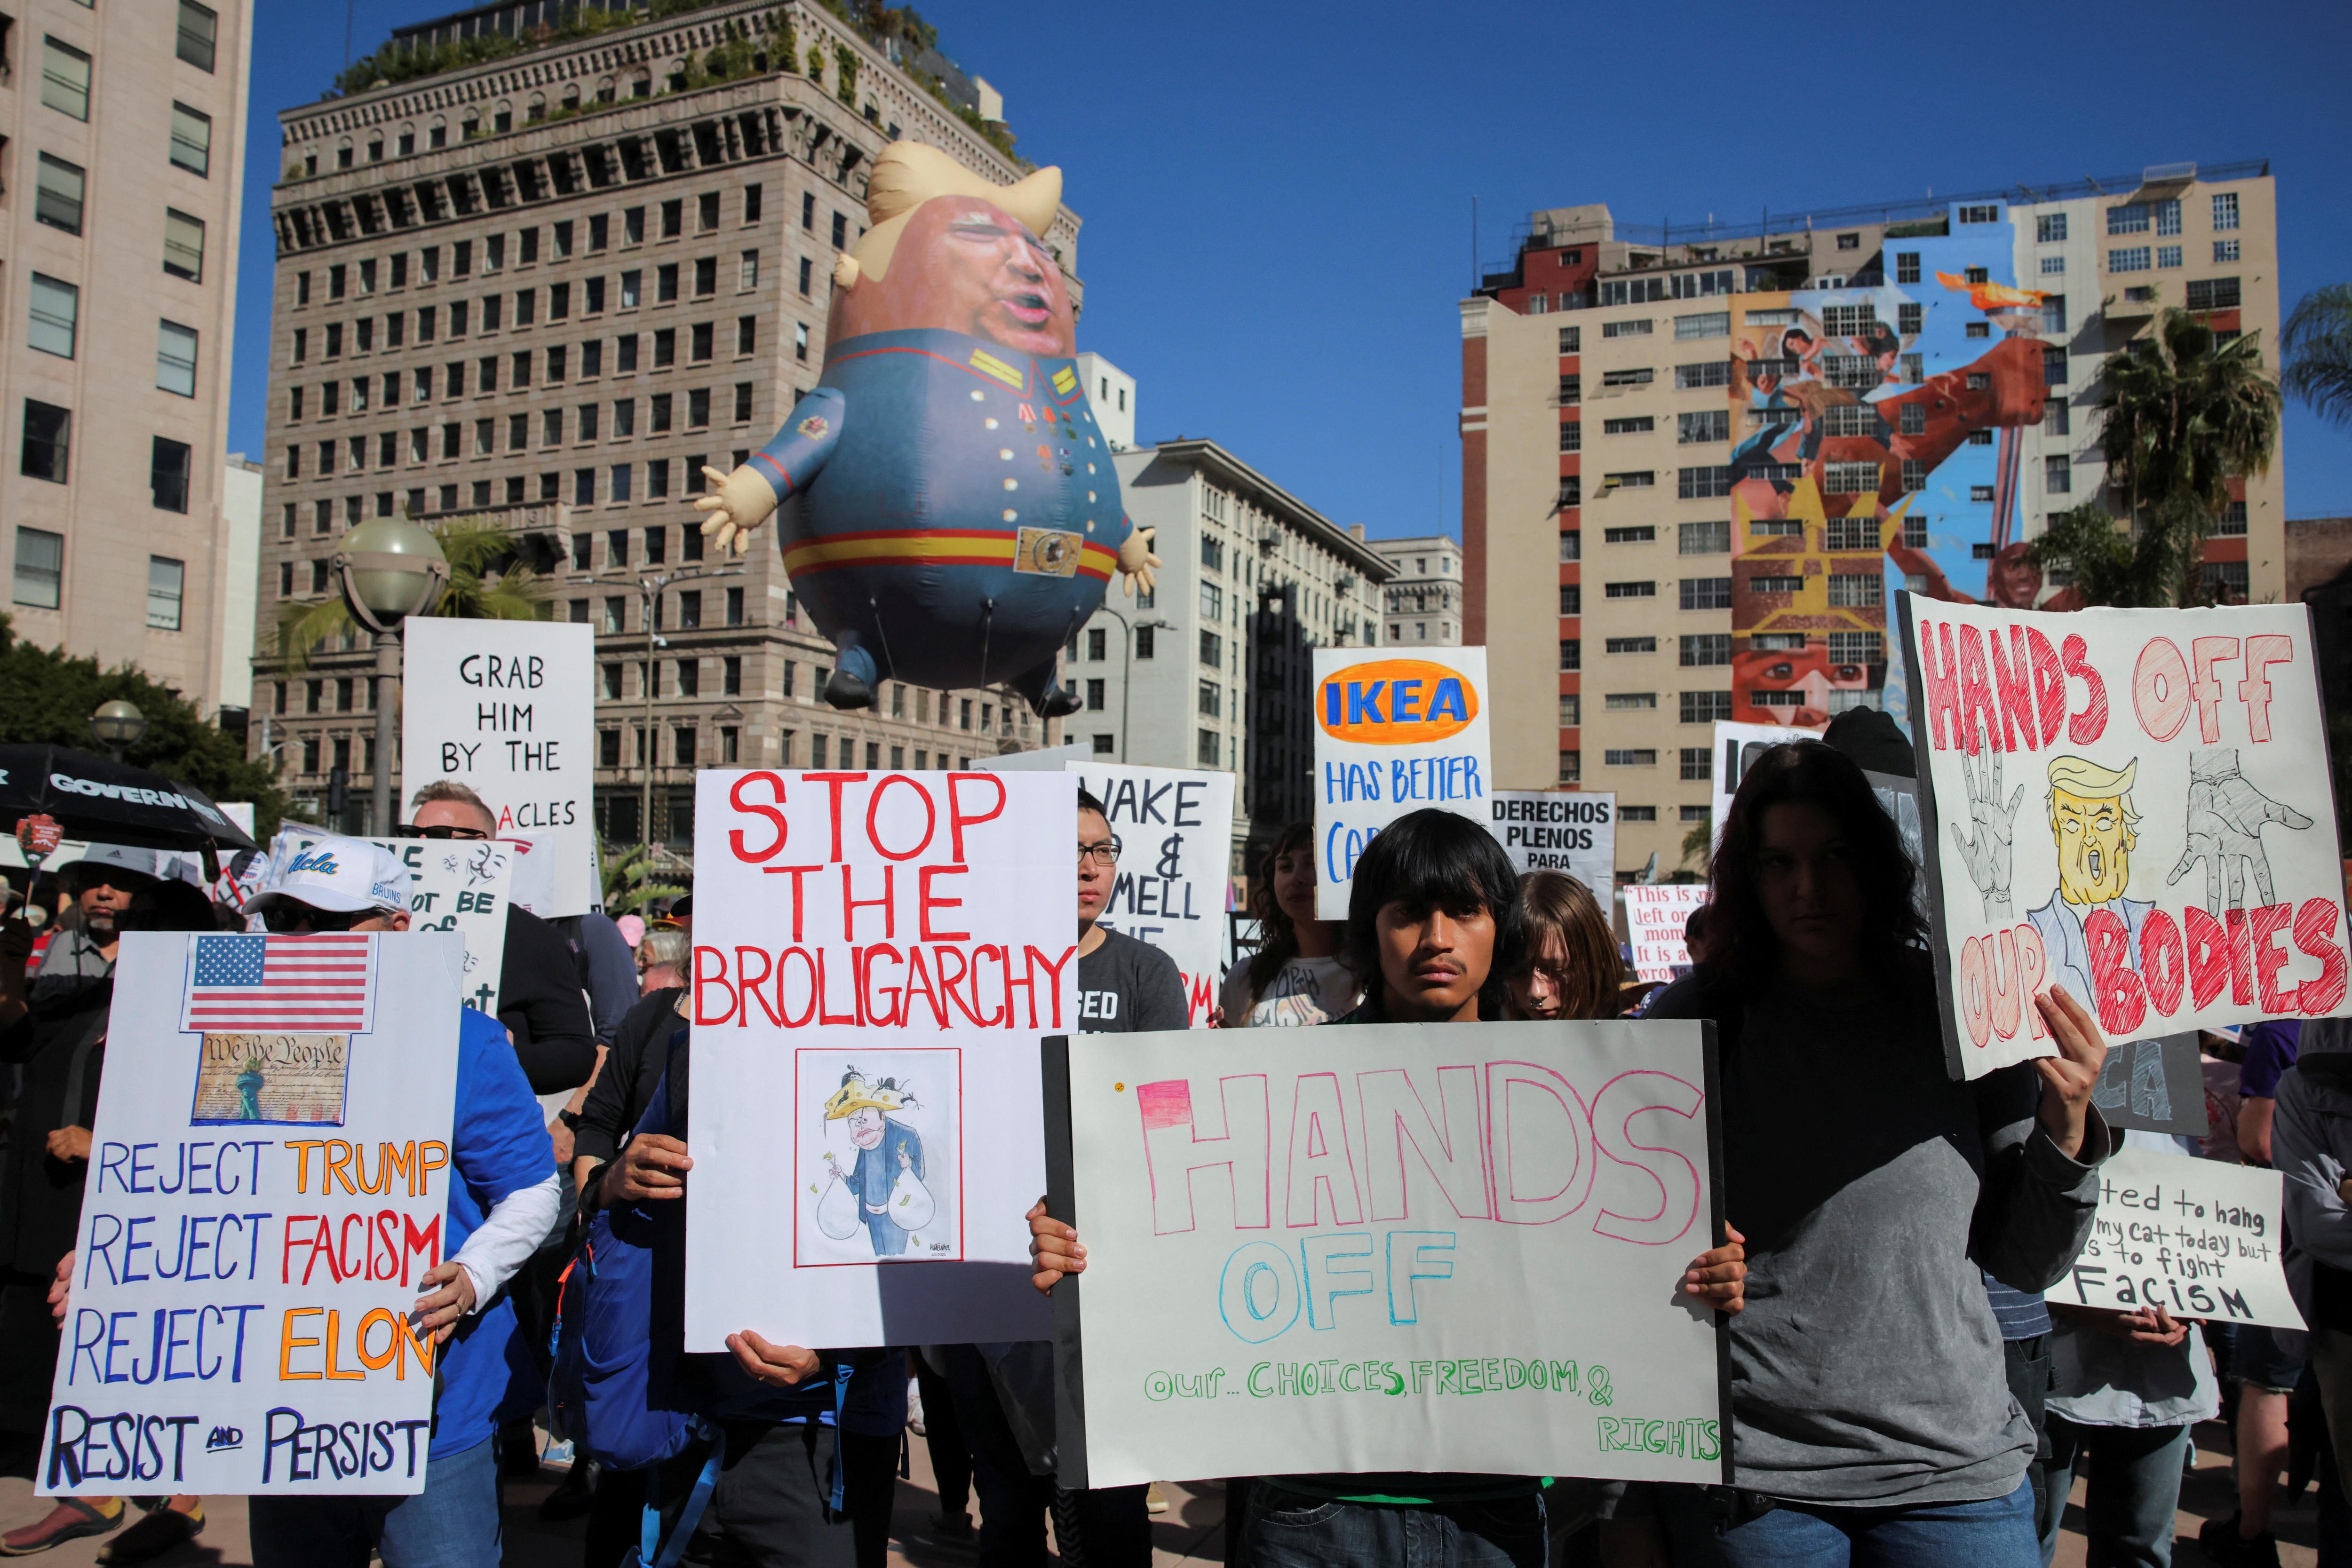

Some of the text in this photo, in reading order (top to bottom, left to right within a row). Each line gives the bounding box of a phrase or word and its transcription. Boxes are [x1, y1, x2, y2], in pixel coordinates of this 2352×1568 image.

[460, 654, 544, 689] GRAB
[1920, 619, 2294, 757] HANDS OFF
[478, 702, 532, 732] HIM
[1326, 678, 1468, 726] IKEA
[442, 741, 560, 773] BY THE
[1326, 755, 1483, 805] HAS BETTER
[498, 800, 576, 831] ACLES
[729, 771, 1006, 863] STOP
[1492, 800, 1610, 824] DERECHOS
[1507, 826, 1593, 849] PLENOS
[1527, 852, 1571, 869] PARA
[371, 882, 401, 903] BRUINS
[412, 891, 496, 914] OT BE
[763, 864, 971, 942] THE
[1105, 871, 1201, 920] MELL
[1676, 885, 1690, 902] is
[1637, 907, 1664, 923] left
[1645, 928, 1685, 942] mom
[1637, 945, 1651, 962] It
[1657, 946, 1671, 962] is
[2084, 897, 2349, 1036] BODIES
[694, 942, 1078, 1031] BROLIGARCHY
[207, 1036, 242, 1062] We
[274, 1036, 342, 1069] People
[97, 1139, 449, 1197] REJECT TRUMP
[1136, 1060, 1706, 1245] HANDS
[2100, 1179, 2160, 1211] ted
[2173, 1189, 2205, 1217] to
[84, 1209, 441, 1290] REJECT FACISM
[2097, 1218, 2124, 1246] my
[2175, 1226, 2230, 1258] today
[2238, 1237, 2272, 1262] but
[2114, 1243, 2143, 1265] to
[2156, 1247, 2226, 1280] fight
[1218, 1230, 1457, 1345] OFF
[68, 1305, 437, 1387] REJECT ELON
[1586, 1364, 1614, 1407] &
[46, 1404, 430, 1490] RESIST AND PERSIST
[1597, 1416, 1722, 1462] RIGHTS
